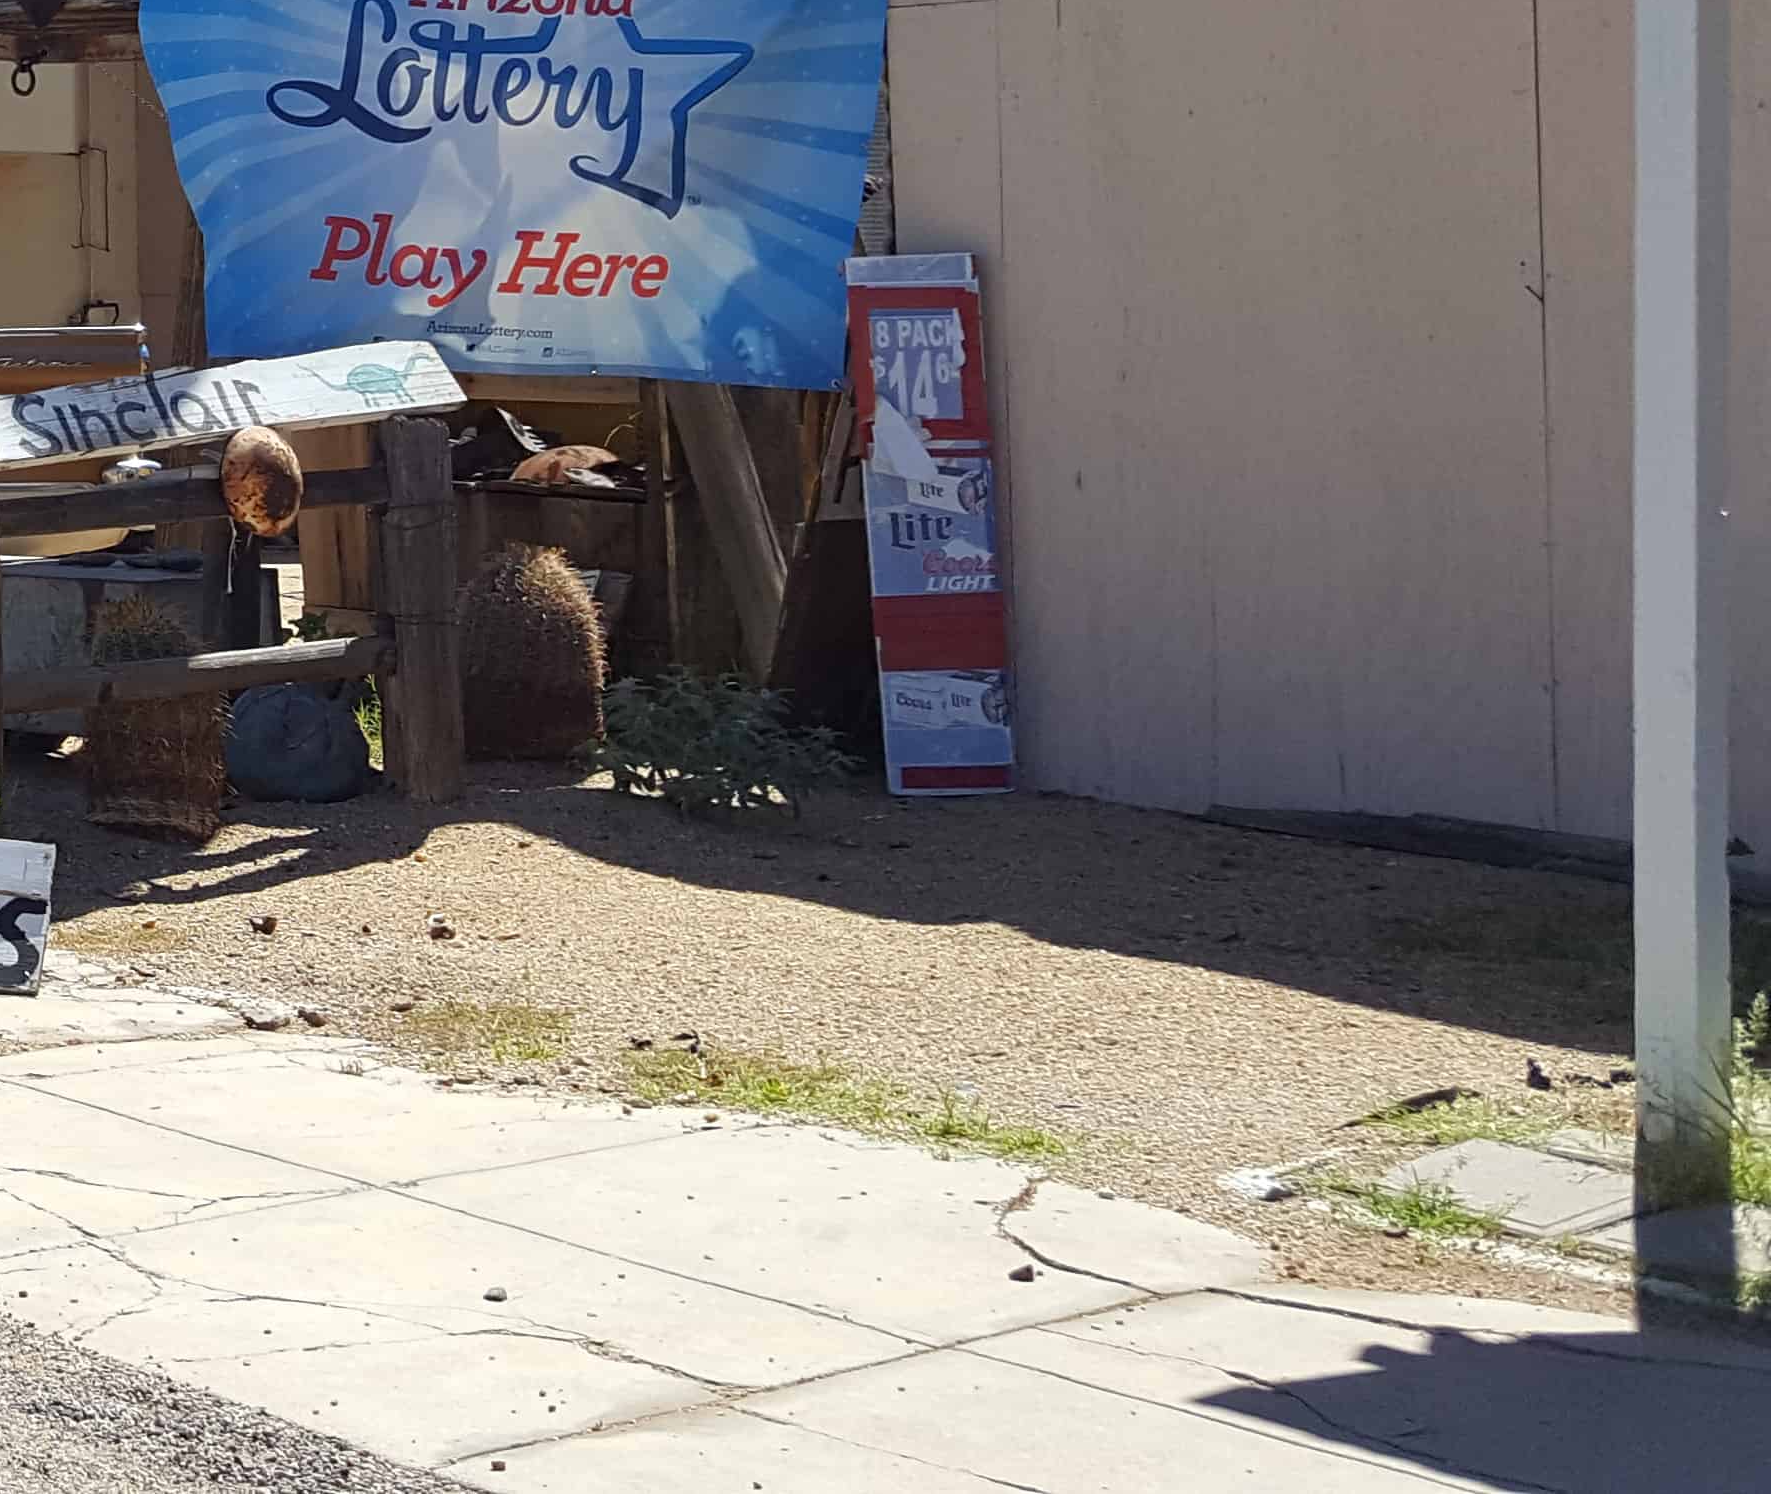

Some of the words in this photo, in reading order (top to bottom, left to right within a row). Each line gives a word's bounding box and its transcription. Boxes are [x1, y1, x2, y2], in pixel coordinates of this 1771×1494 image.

[309, 213, 488, 308] Play
[497, 229, 669, 299] Here
[425, 320, 554, 341] ArizonaLottery.com
[875, 320, 890, 348] 8
[890, 511, 954, 551] Lite
[925, 574, 996, 593] LIGHT
